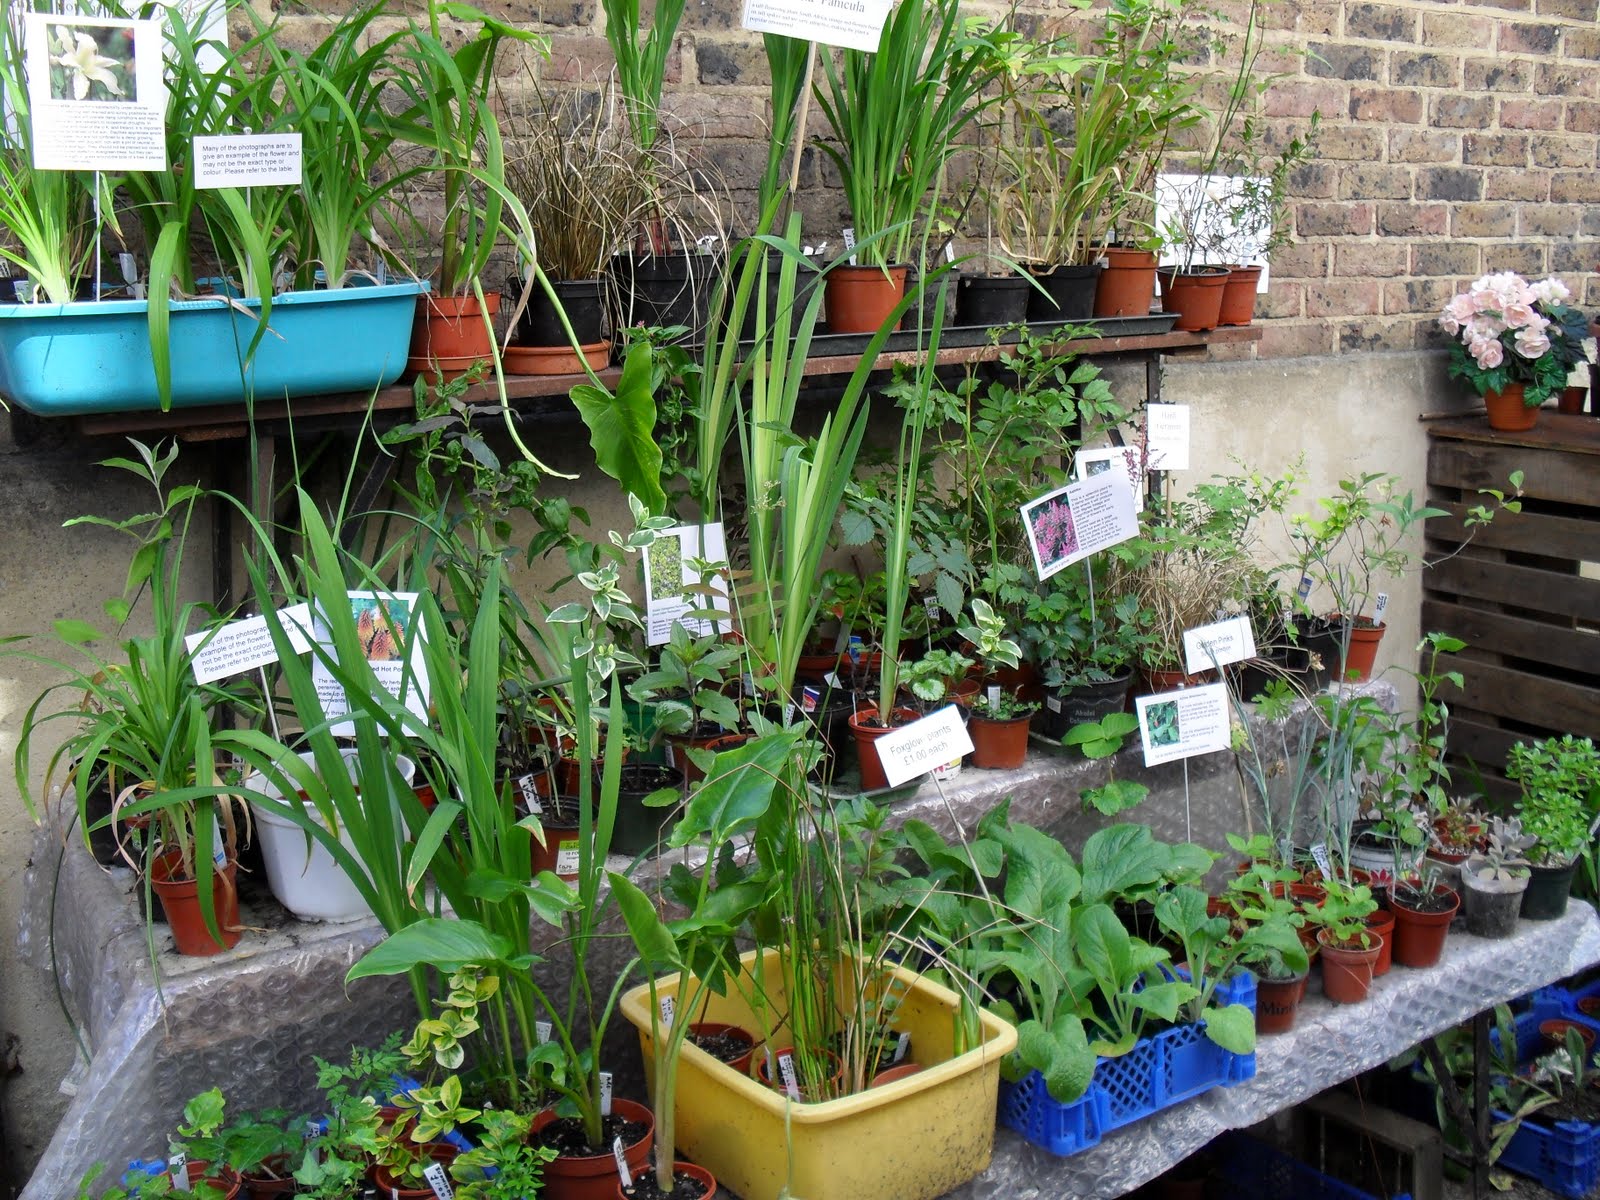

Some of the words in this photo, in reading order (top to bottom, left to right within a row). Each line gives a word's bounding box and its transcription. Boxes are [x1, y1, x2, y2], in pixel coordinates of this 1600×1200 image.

[239, 144, 274, 152] photographs
[226, 152, 250, 160] example
[216, 637, 223, 645] of
[224, 635, 234, 643] the
[236, 626, 267, 641] photograp
[200, 645, 226, 658] example
[235, 639, 245, 647] the
[247, 634, 265, 643] flower
[235, 648, 251, 656] exact
[204, 664, 225, 673] Please
[227, 659, 242, 667] refer
[927, 725, 952, 742] plants
[928, 741, 949, 756] each
